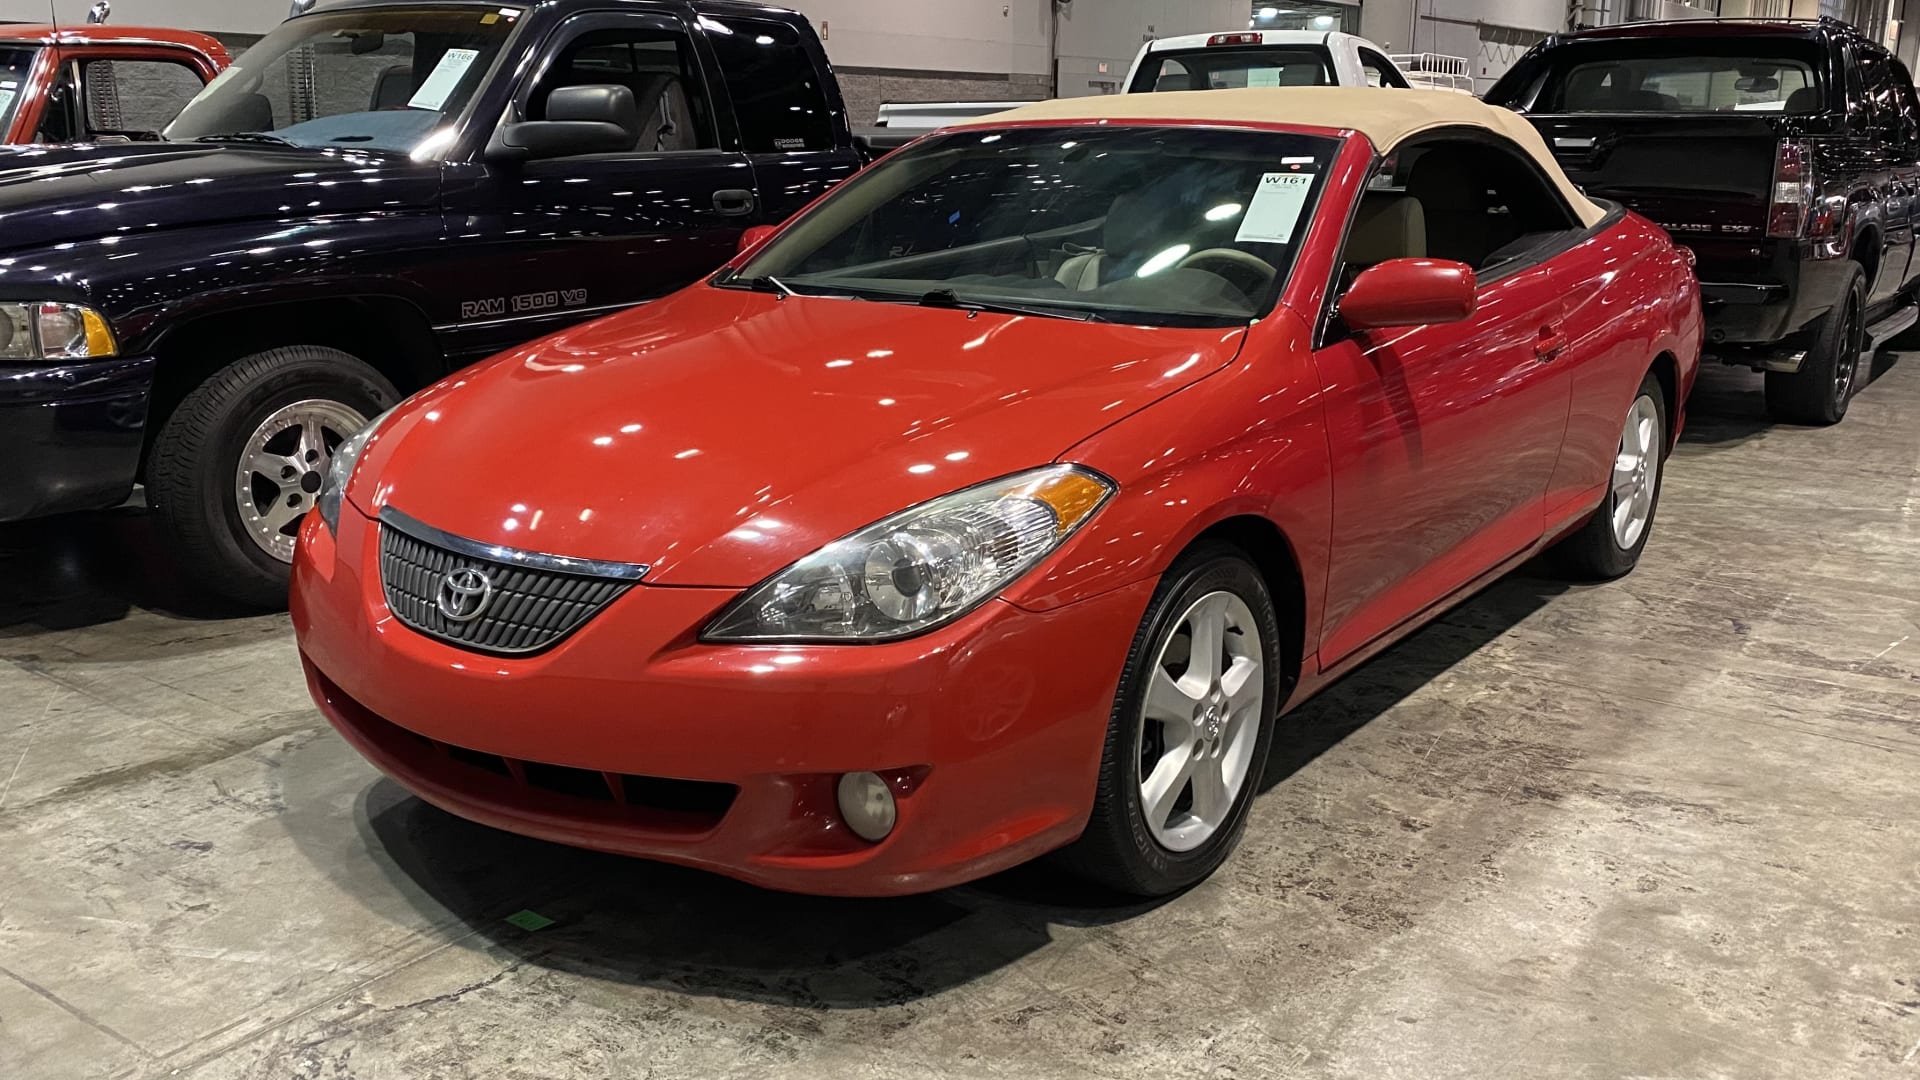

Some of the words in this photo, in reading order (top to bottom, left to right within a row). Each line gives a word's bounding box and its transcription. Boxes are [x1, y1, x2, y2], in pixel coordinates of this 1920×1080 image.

[447, 52, 474, 61] W166
[1265, 176, 1308, 185] W161
[1655, 222, 1712, 232] ALADE
[461, 297, 505, 319] RAM
[511, 291, 558, 312] 1500
[560, 288, 587, 302] V8
